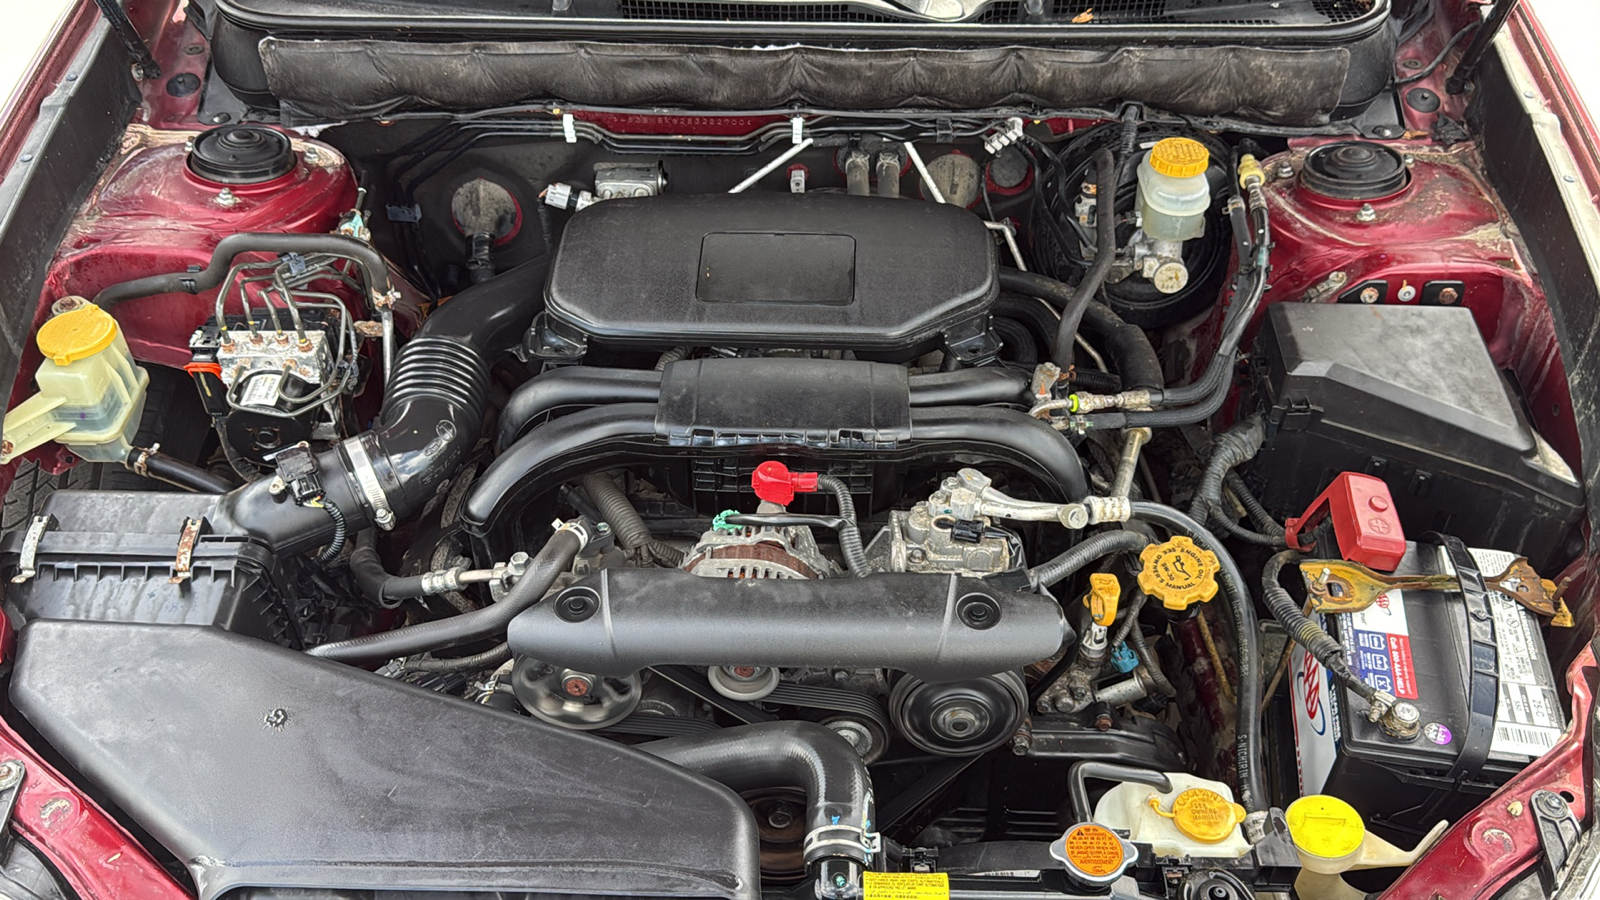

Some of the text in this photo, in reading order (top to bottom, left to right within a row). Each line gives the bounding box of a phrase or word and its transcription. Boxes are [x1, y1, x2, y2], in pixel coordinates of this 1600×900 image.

[1161, 562, 1175, 581] 5W-30
[1180, 548, 1204, 580] ENGINE OIL
[1389, 637, 1404, 693] Call: 800-AAA-HELP
[1176, 789, 1225, 806] COOLANT
